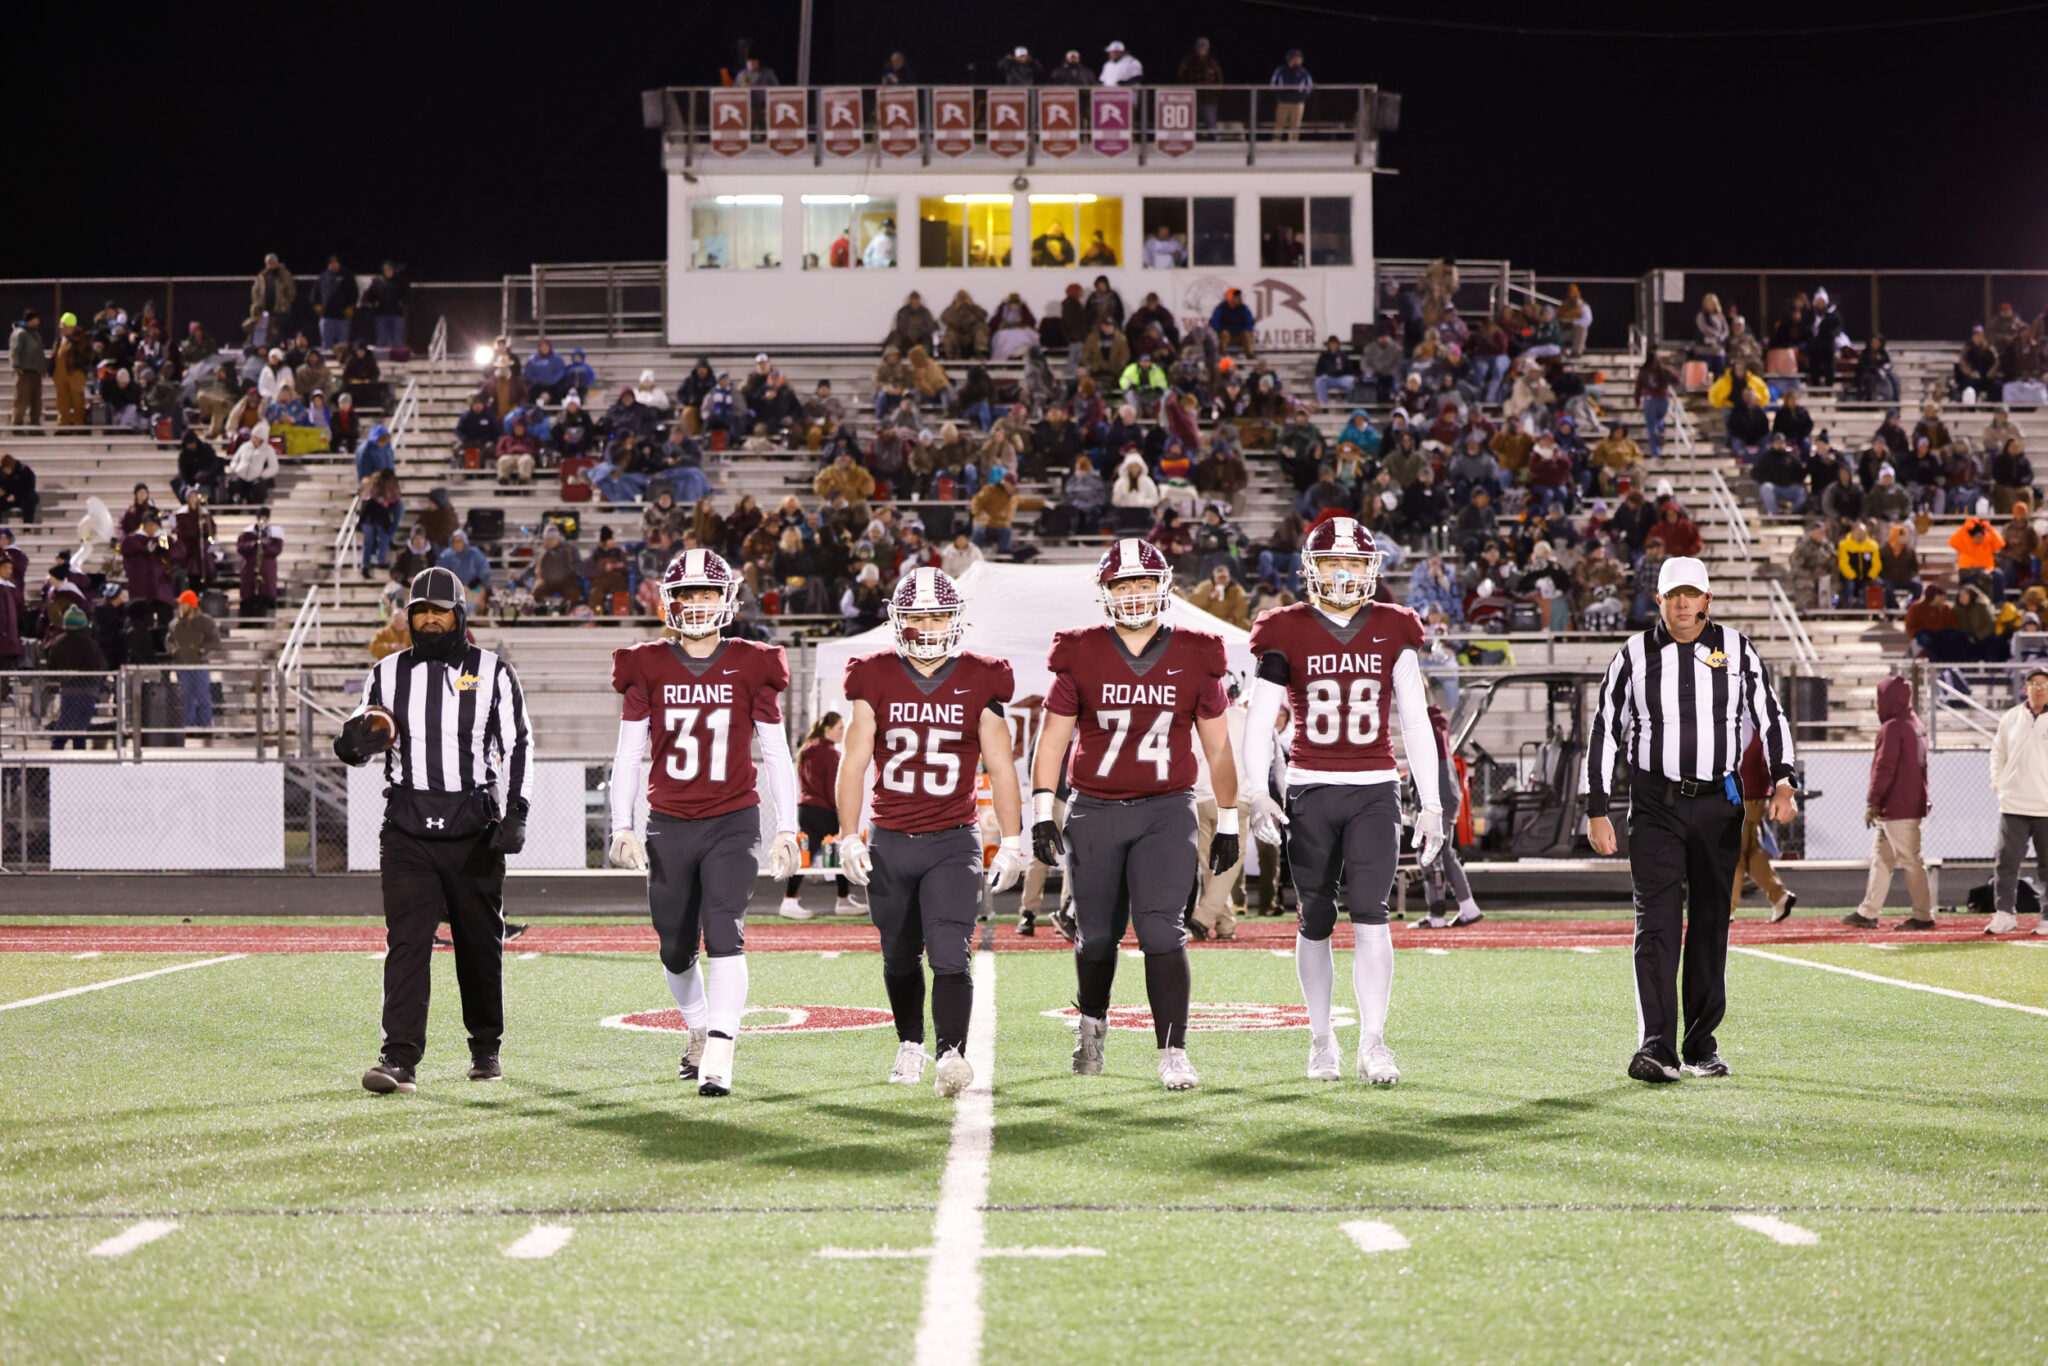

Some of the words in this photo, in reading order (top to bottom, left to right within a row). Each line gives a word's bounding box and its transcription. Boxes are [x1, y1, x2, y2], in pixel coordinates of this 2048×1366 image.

[1162, 104, 1189, 128] 80
[1307, 654, 1382, 675] ROANE
[663, 684, 733, 704] ROANE
[1102, 684, 1177, 706] ROANE
[889, 703, 964, 724] ROANE
[1305, 678, 1382, 745] 88
[664, 708, 731, 782] 31
[1096, 709, 1176, 782] 74
[883, 726, 963, 796] 25
